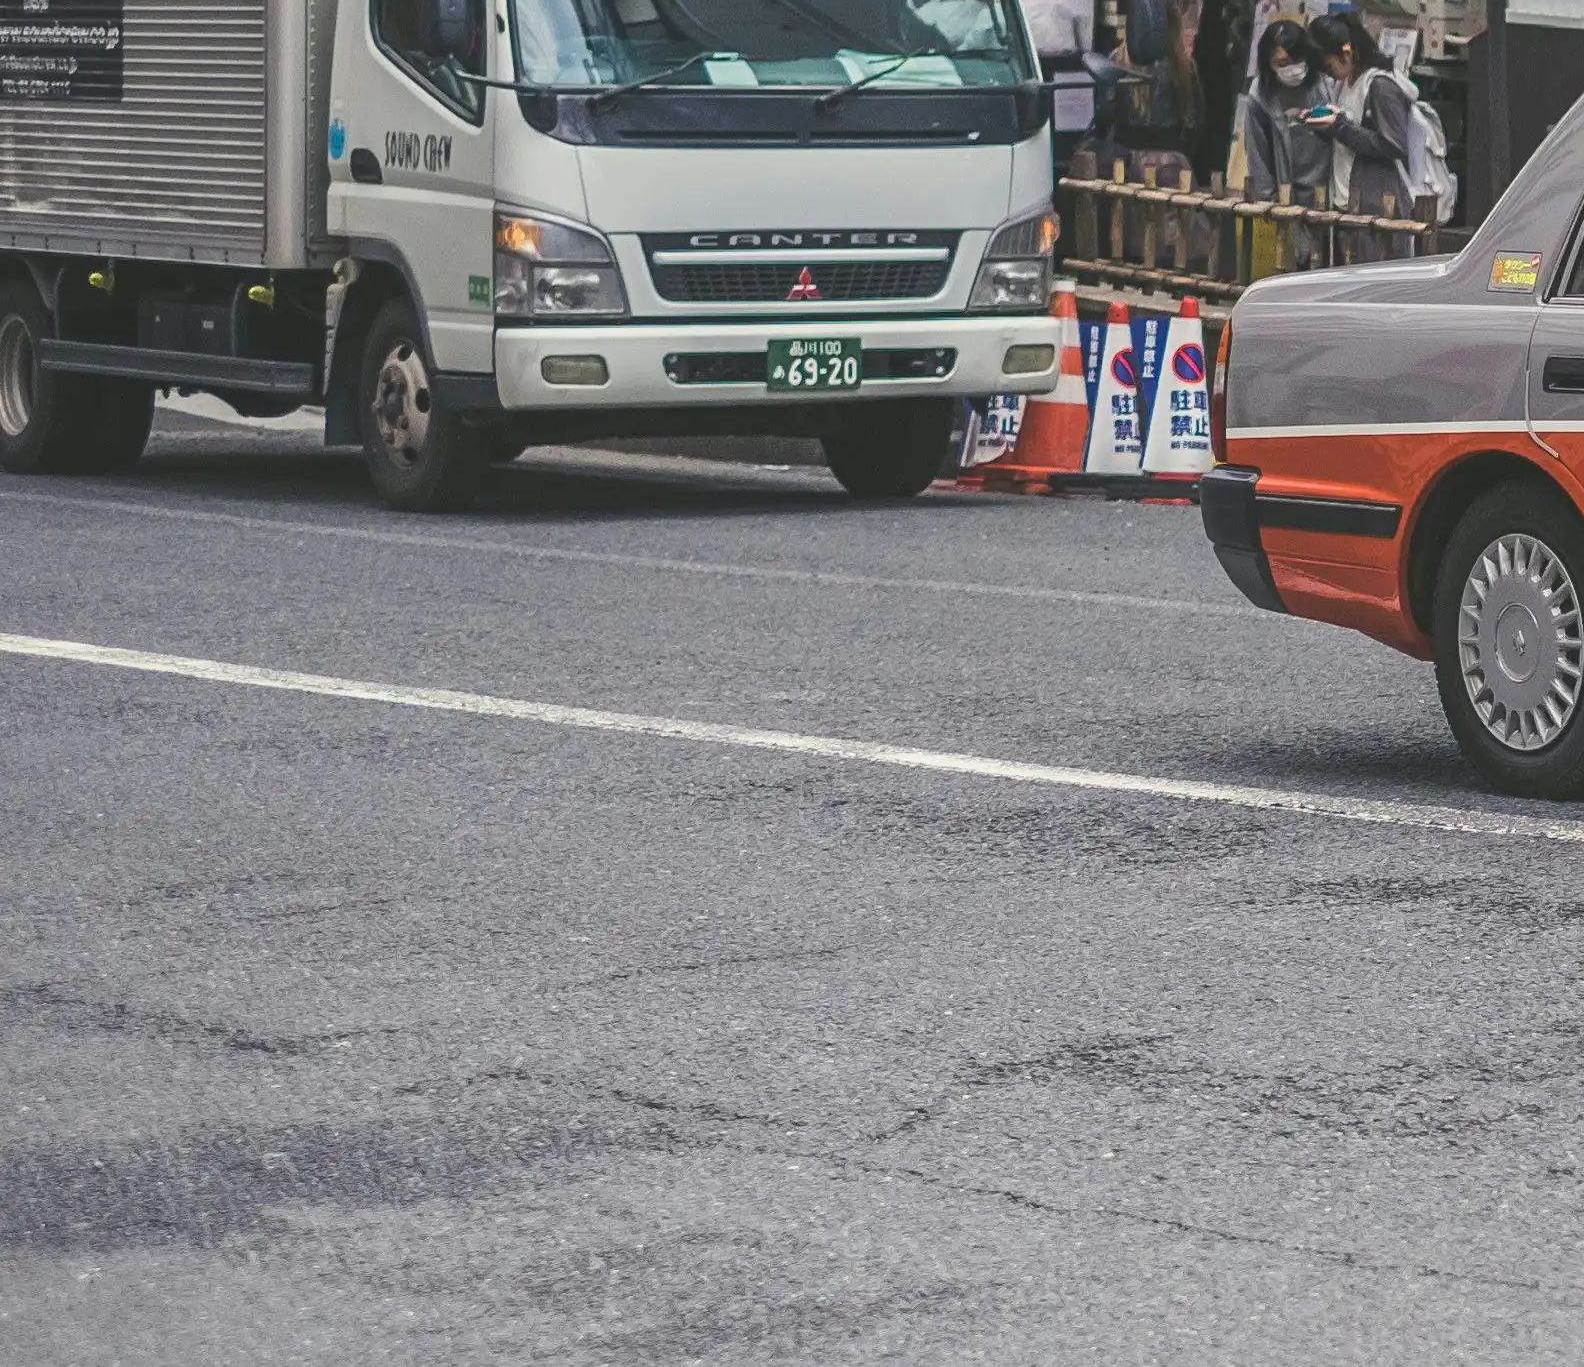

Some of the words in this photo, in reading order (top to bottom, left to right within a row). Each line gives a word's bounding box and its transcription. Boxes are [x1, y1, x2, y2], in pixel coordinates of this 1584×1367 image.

[384, 130, 421, 171] SOUND
[423, 134, 453, 172] CREW
[688, 232, 920, 249] CANTER
[788, 340, 842, 357] 品川100
[787, 356, 858, 386] 69-20
[1170, 416, 1209, 436] 禁止
